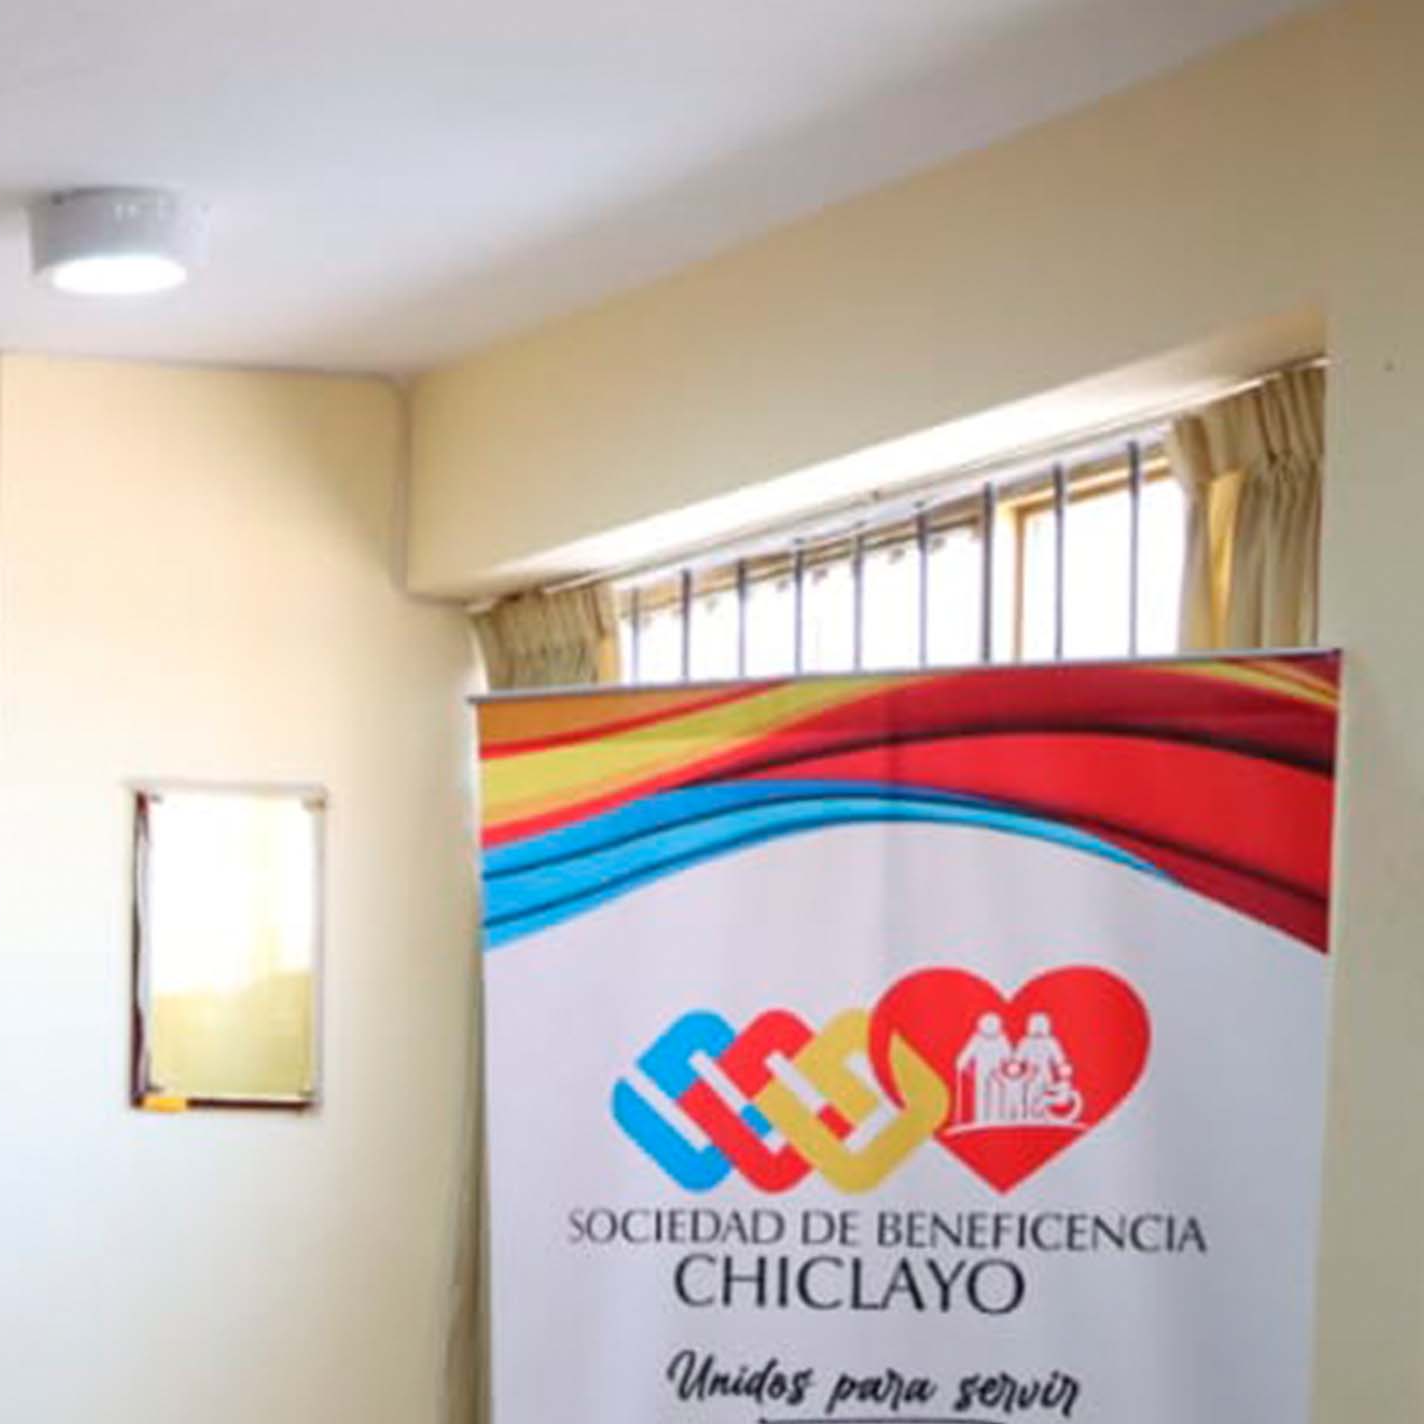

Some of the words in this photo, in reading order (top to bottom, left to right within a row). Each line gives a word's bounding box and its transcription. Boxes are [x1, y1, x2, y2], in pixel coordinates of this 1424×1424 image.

[567, 1208, 786, 1244] SOCIEDAD
[801, 1209, 863, 1246] DE
[877, 1211, 1207, 1254] BENEFICENCIA
[673, 1253, 1025, 1315] CHICLAYO
[663, 1348, 813, 1406] Unidos
[825, 1368, 938, 1415] para
[954, 1371, 1081, 1418] servir
